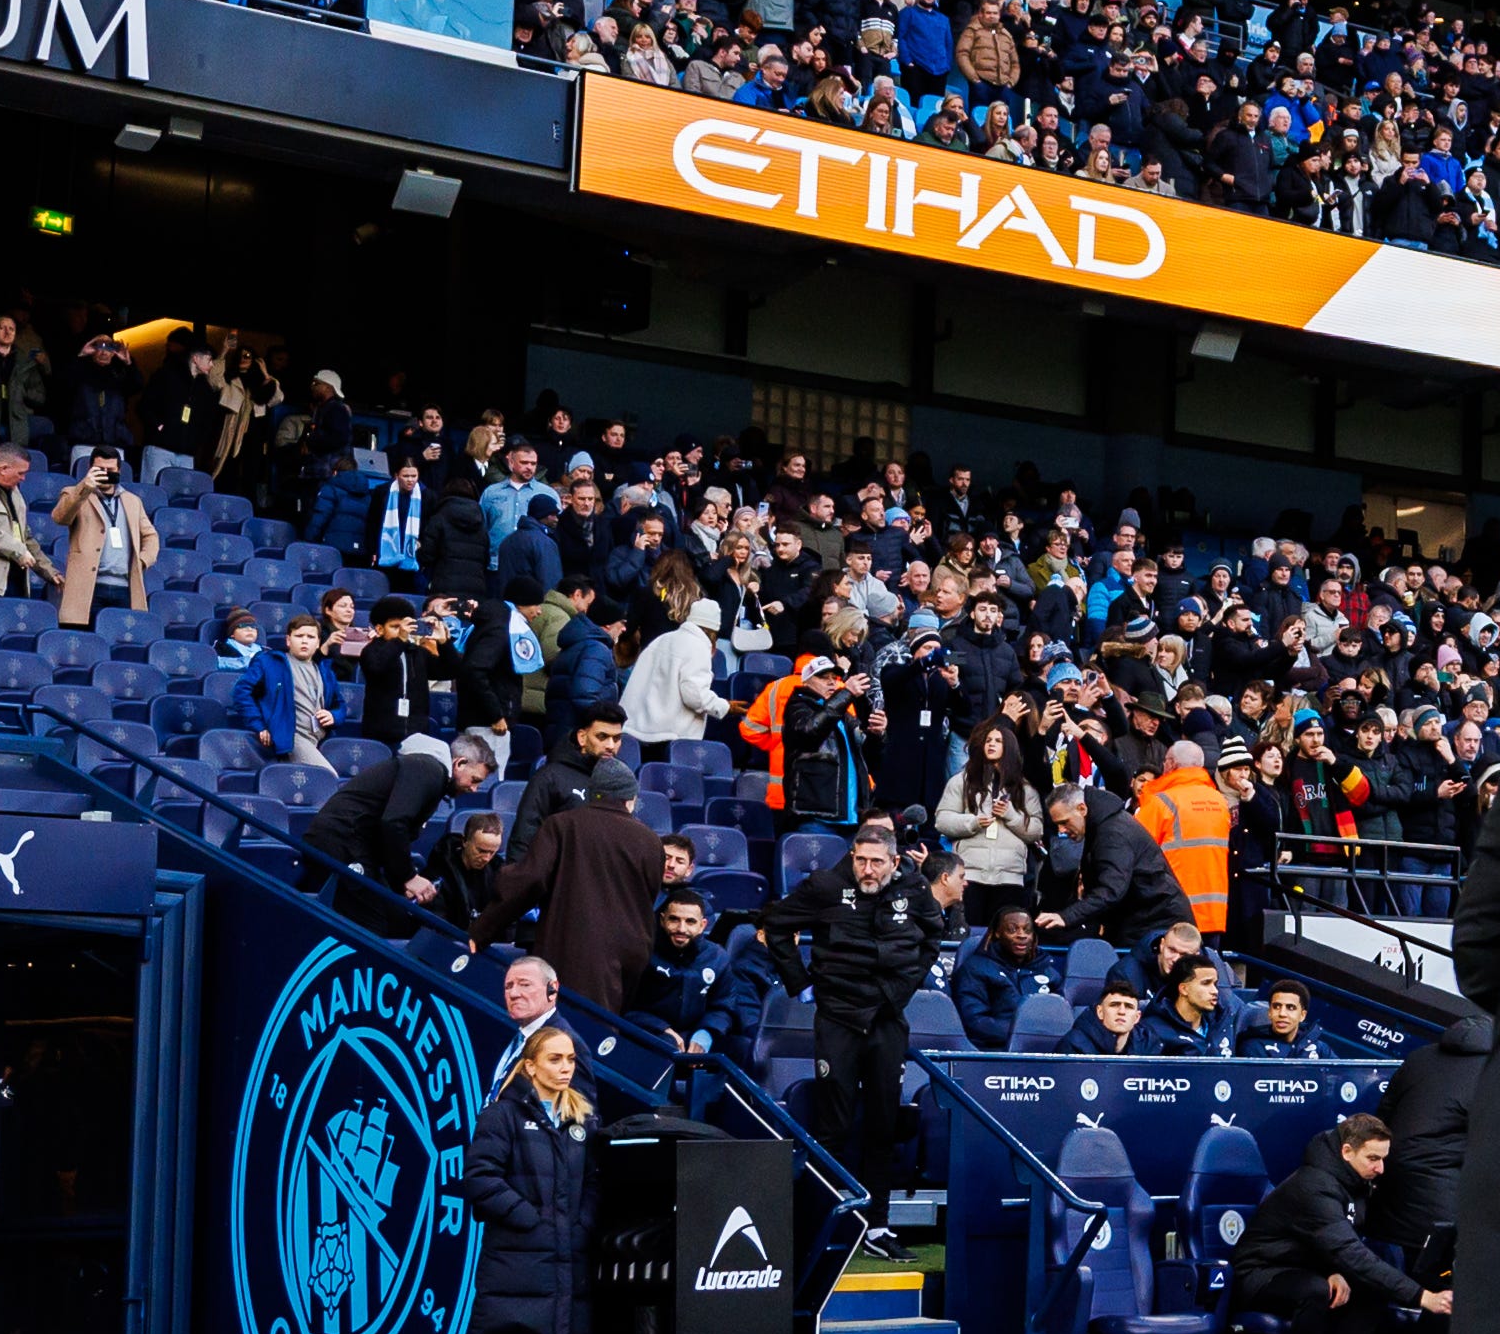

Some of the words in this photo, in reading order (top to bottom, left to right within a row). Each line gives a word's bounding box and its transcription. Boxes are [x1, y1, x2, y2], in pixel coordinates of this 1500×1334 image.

[672, 118, 1166, 279] ETIHAD
[1358, 1019, 1405, 1044] ETIHAD
[1362, 1034, 1389, 1049] AIRWAYS
[984, 1075, 1055, 1090] ETIHAD
[1123, 1077, 1191, 1092] ETIHAD
[1254, 1079, 1319, 1093] ETIHAD
[271, 1073, 289, 1110] 18
[1000, 1091, 1040, 1102] AIRWAYS
[1138, 1092, 1177, 1103] AIRWAYS
[1269, 1094, 1305, 1104] AIRWAYS
[299, 967, 465, 1237] MANCHESTER
[695, 1264, 782, 1291] Lucozade
[420, 1287, 444, 1334] 94
